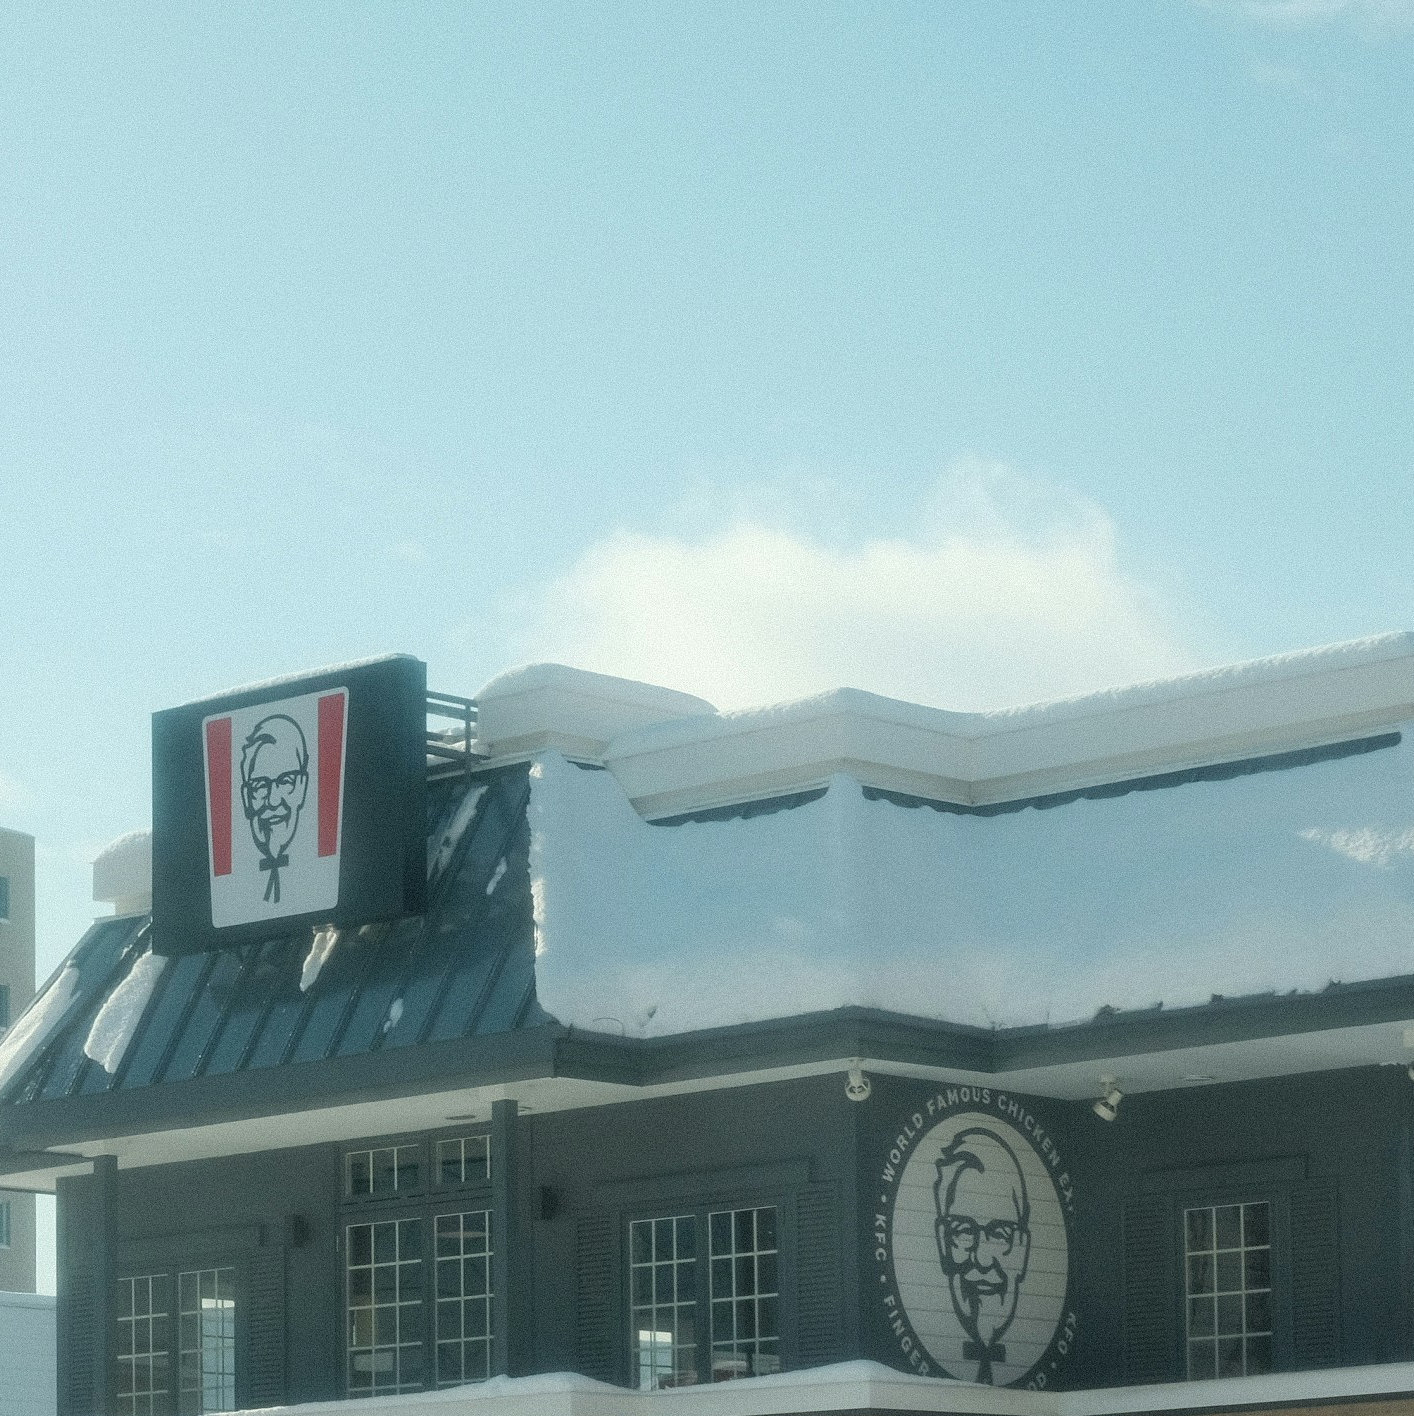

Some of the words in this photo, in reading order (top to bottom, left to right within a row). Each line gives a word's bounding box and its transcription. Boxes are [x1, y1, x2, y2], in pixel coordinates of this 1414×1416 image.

[882, 1113, 924, 1183] WORLD
[926, 1087, 992, 1117] FAMOUS
[997, 1095, 1061, 1168] CHICKEN
[874, 1213, 887, 1262] KFC
